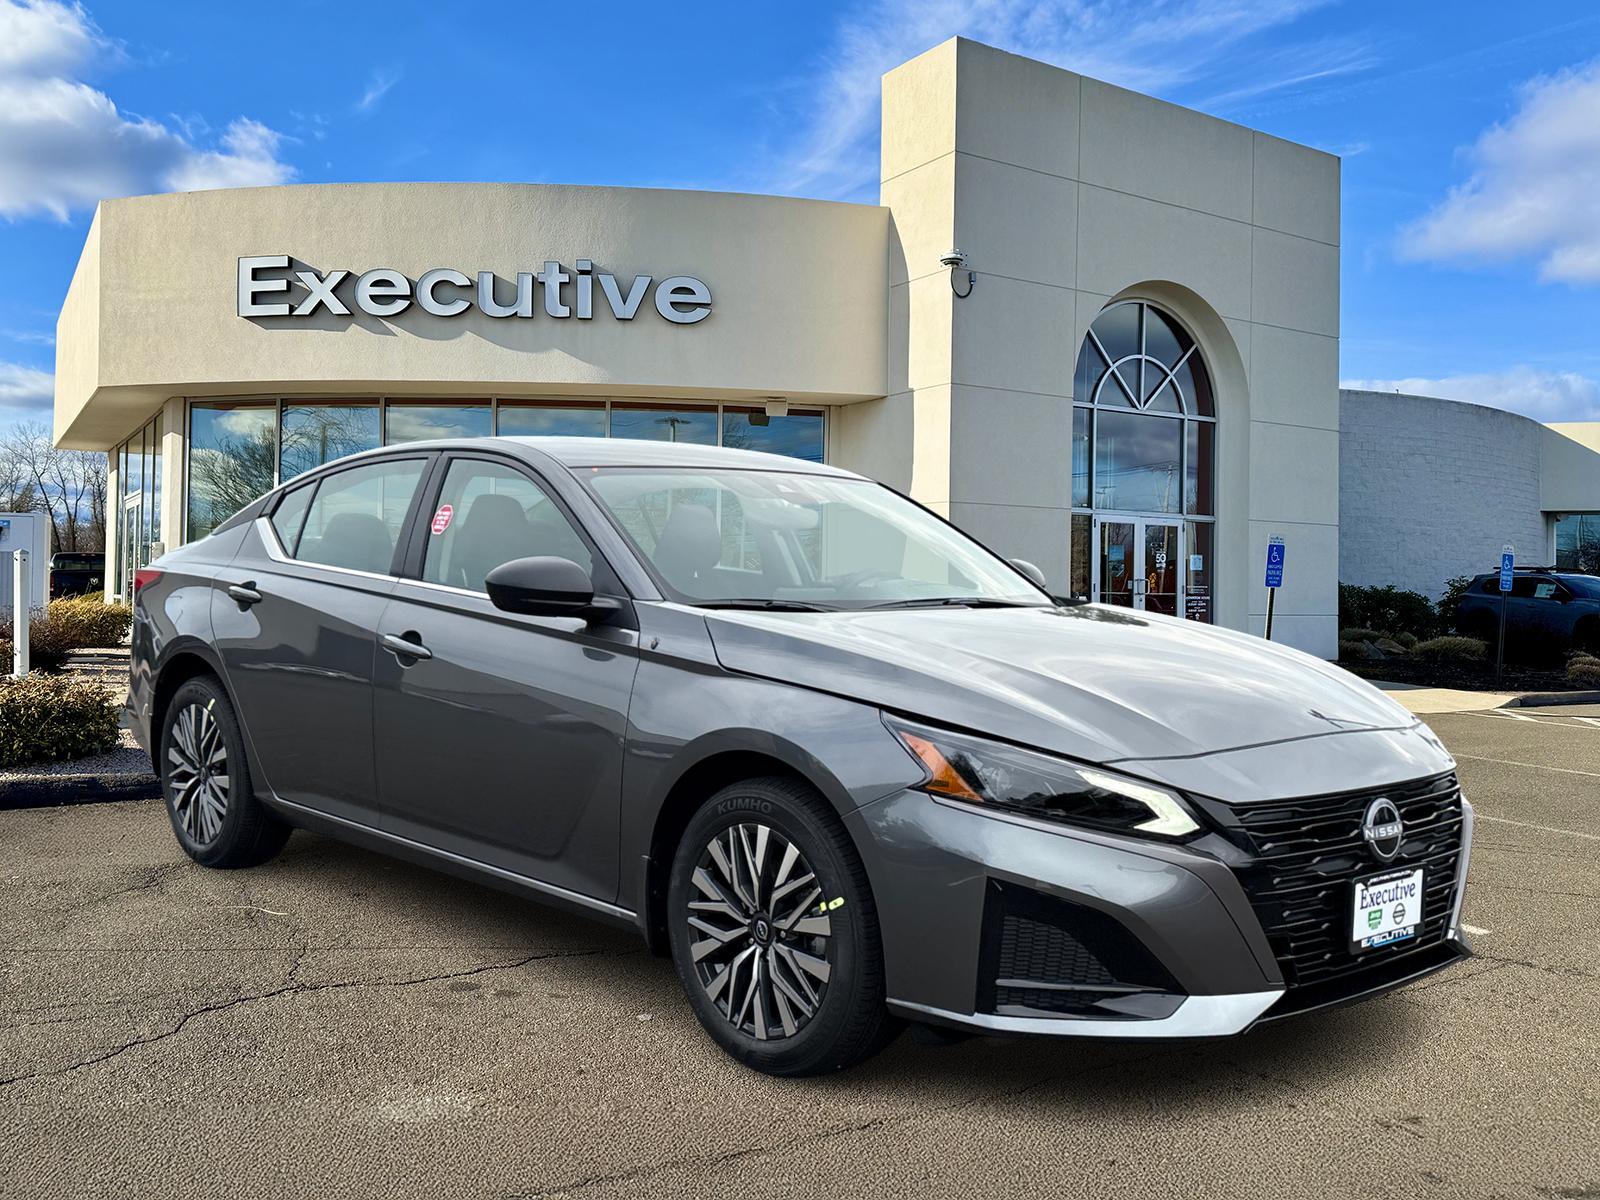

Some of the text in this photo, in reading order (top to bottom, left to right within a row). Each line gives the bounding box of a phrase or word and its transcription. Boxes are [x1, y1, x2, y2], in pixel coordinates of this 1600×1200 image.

[237, 254, 712, 323] Executive
[1155, 553, 1167, 563] 50
[718, 798, 772, 814] KUMHO
[1360, 880, 1416, 910] Executive
